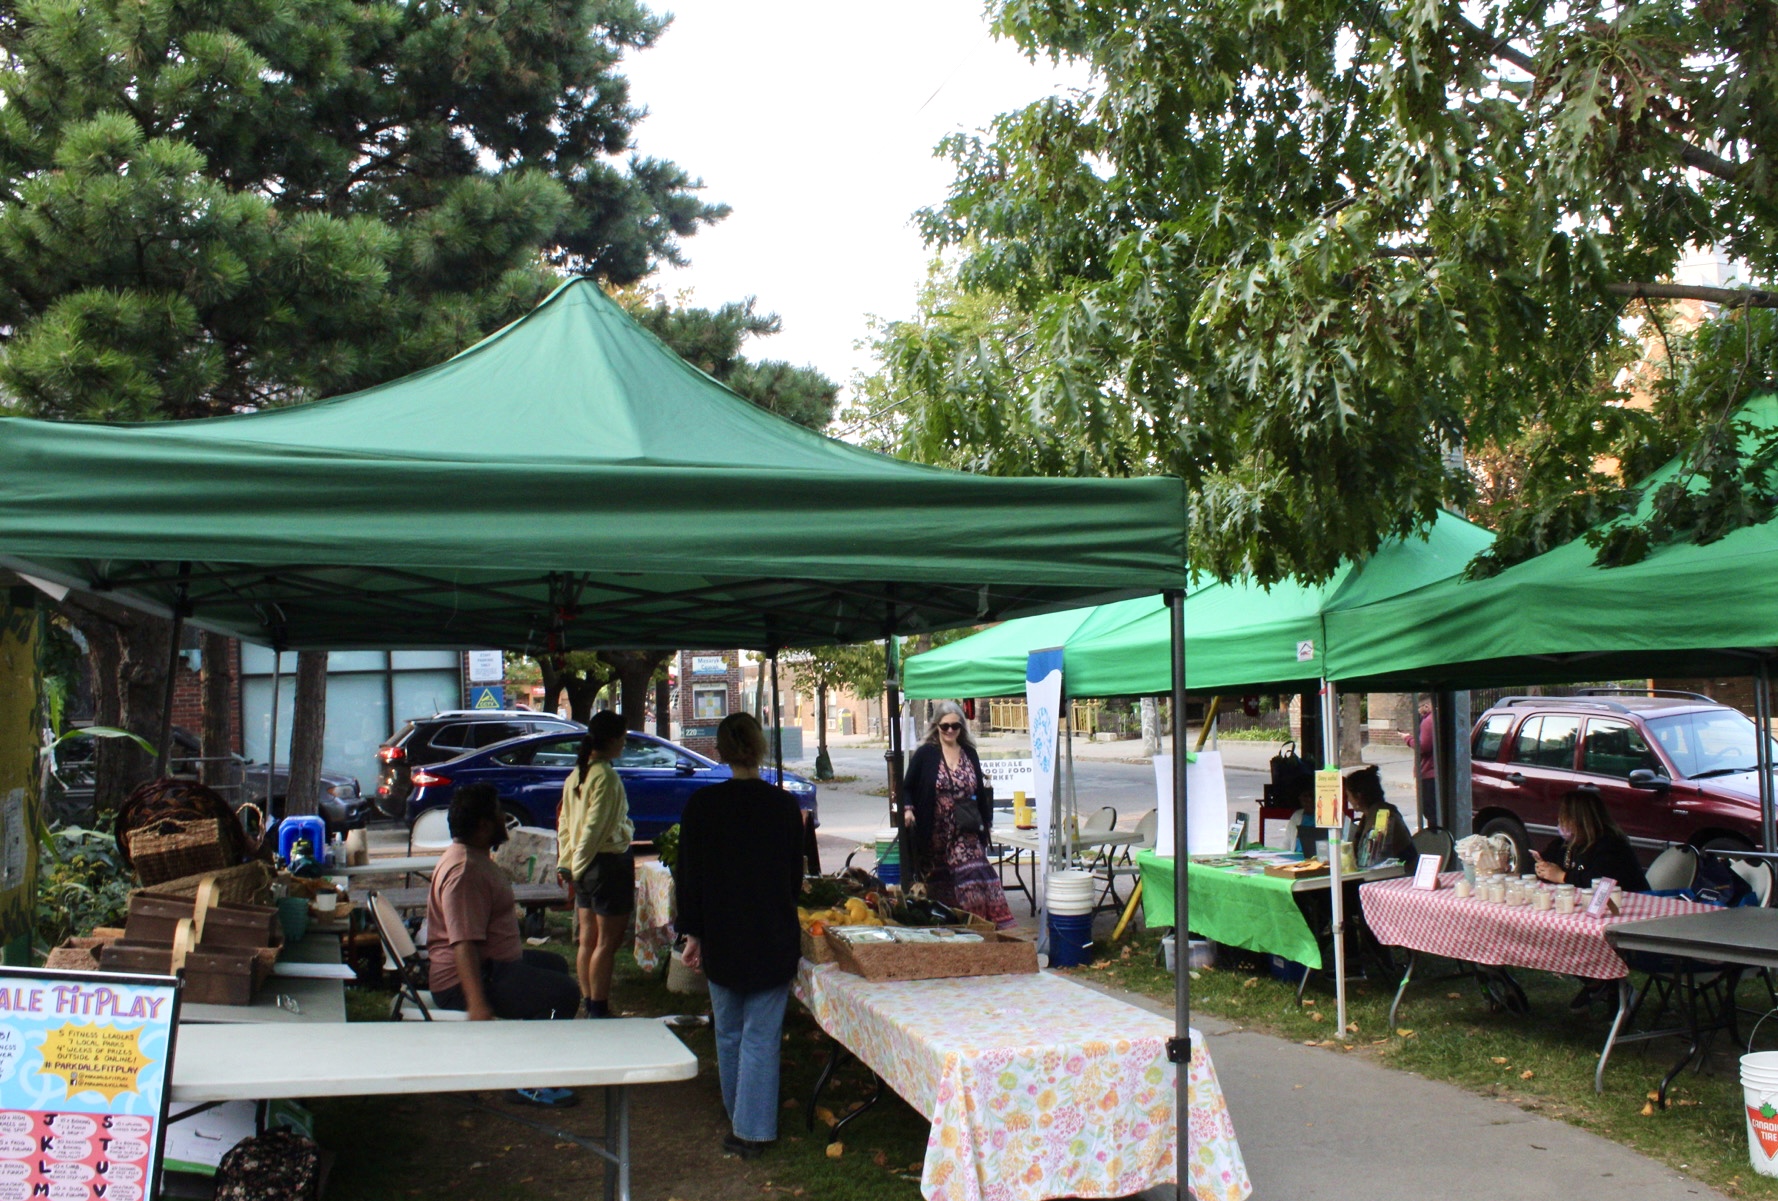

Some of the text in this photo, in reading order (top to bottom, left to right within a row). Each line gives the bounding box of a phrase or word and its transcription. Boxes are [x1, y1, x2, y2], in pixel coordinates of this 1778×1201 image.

[0, 988, 44, 1012] ALE
[102, 1032, 134, 1041] LEADERS
[57, 1053, 90, 1061] OUTSIDE
[107, 1048, 132, 1056] PRIZES
[43, 1113, 58, 1126] J
[102, 1115, 113, 1128] S
[1760, 1131, 1778, 1142] TIRE
[41, 1136, 54, 1152] K
[99, 1138, 112, 1151] T
[39, 1160, 52, 1174] L
[96, 1161, 109, 1174] U
[33, 1183, 50, 1198] M
[92, 1184, 107, 1198] V
